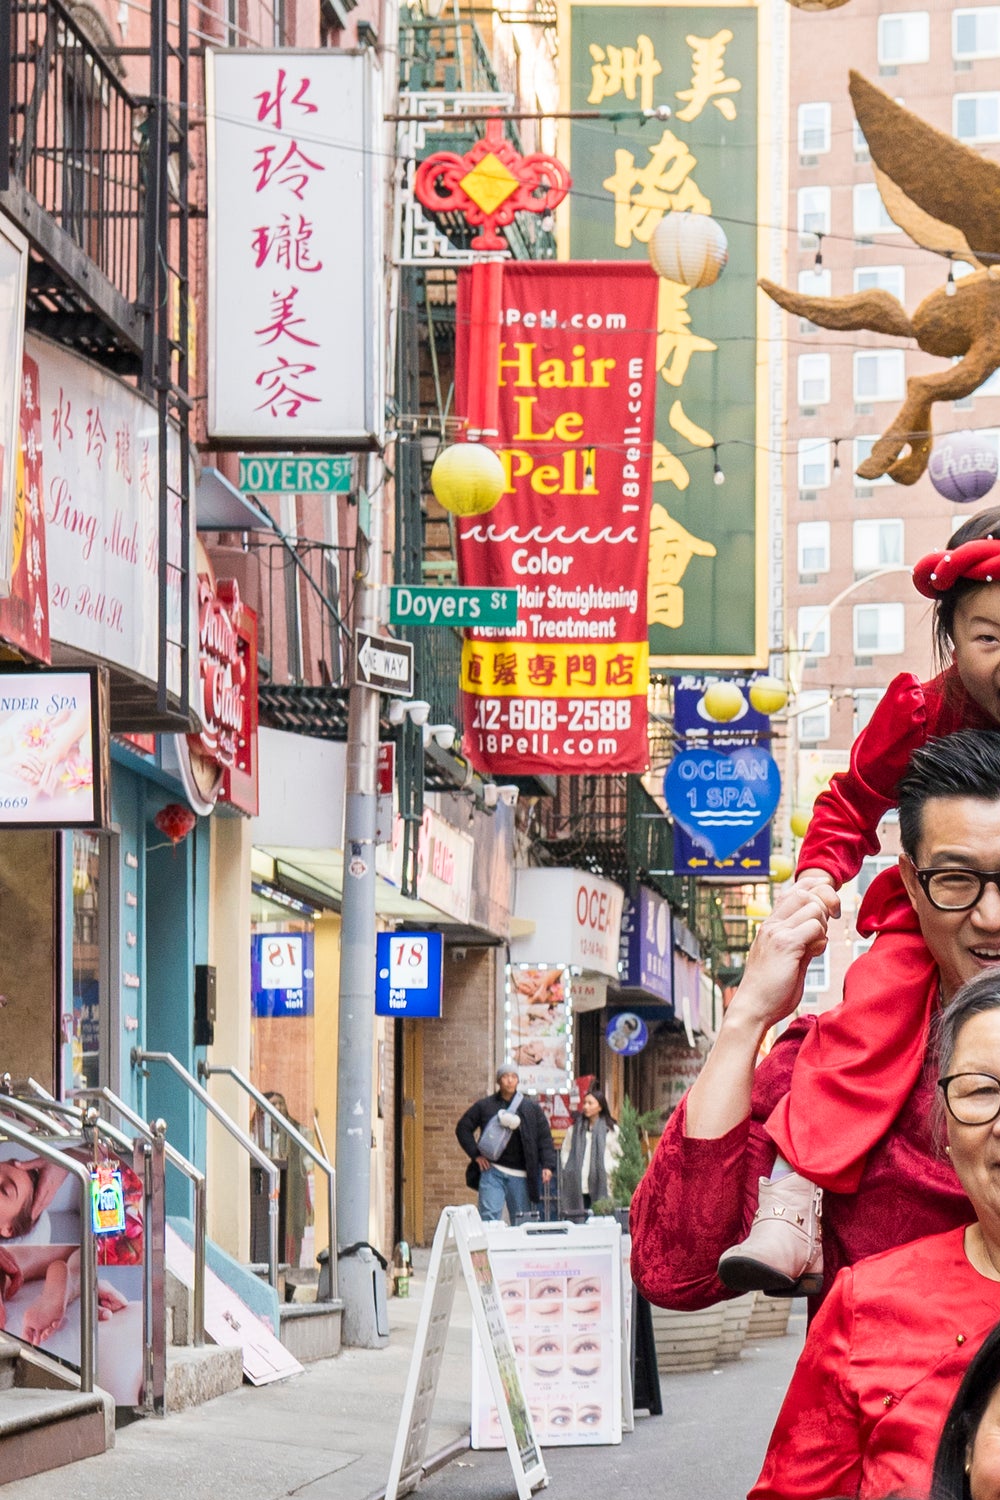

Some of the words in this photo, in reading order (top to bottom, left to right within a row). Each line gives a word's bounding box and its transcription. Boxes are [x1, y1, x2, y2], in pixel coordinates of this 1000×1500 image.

[251, 68, 326, 418] 水玲瓏美容
[497, 342, 617, 389] Hair
[512, 395, 585, 442] Le
[622, 357, 644, 514] 18Pell.com
[332, 459, 350, 477] ST
[496, 447, 600, 496] Pell
[511, 548, 574, 575] Color
[50, 583, 71, 608] 20
[396, 589, 482, 623] Doyers
[490, 592, 508, 611] St
[516, 584, 547, 610] Hair
[546, 583, 639, 616] Straightening
[529, 614, 617, 638] Treatment
[383, 655, 405, 677] WAY
[467, 651, 635, 688] 直髮專門店
[479, 733, 618, 755] 18Pell.com
[678, 758, 769, 781] OCEAN
[686, 787, 698, 809] 1
[706, 786, 757, 809] SPA
[396, 943, 424, 967] 18
